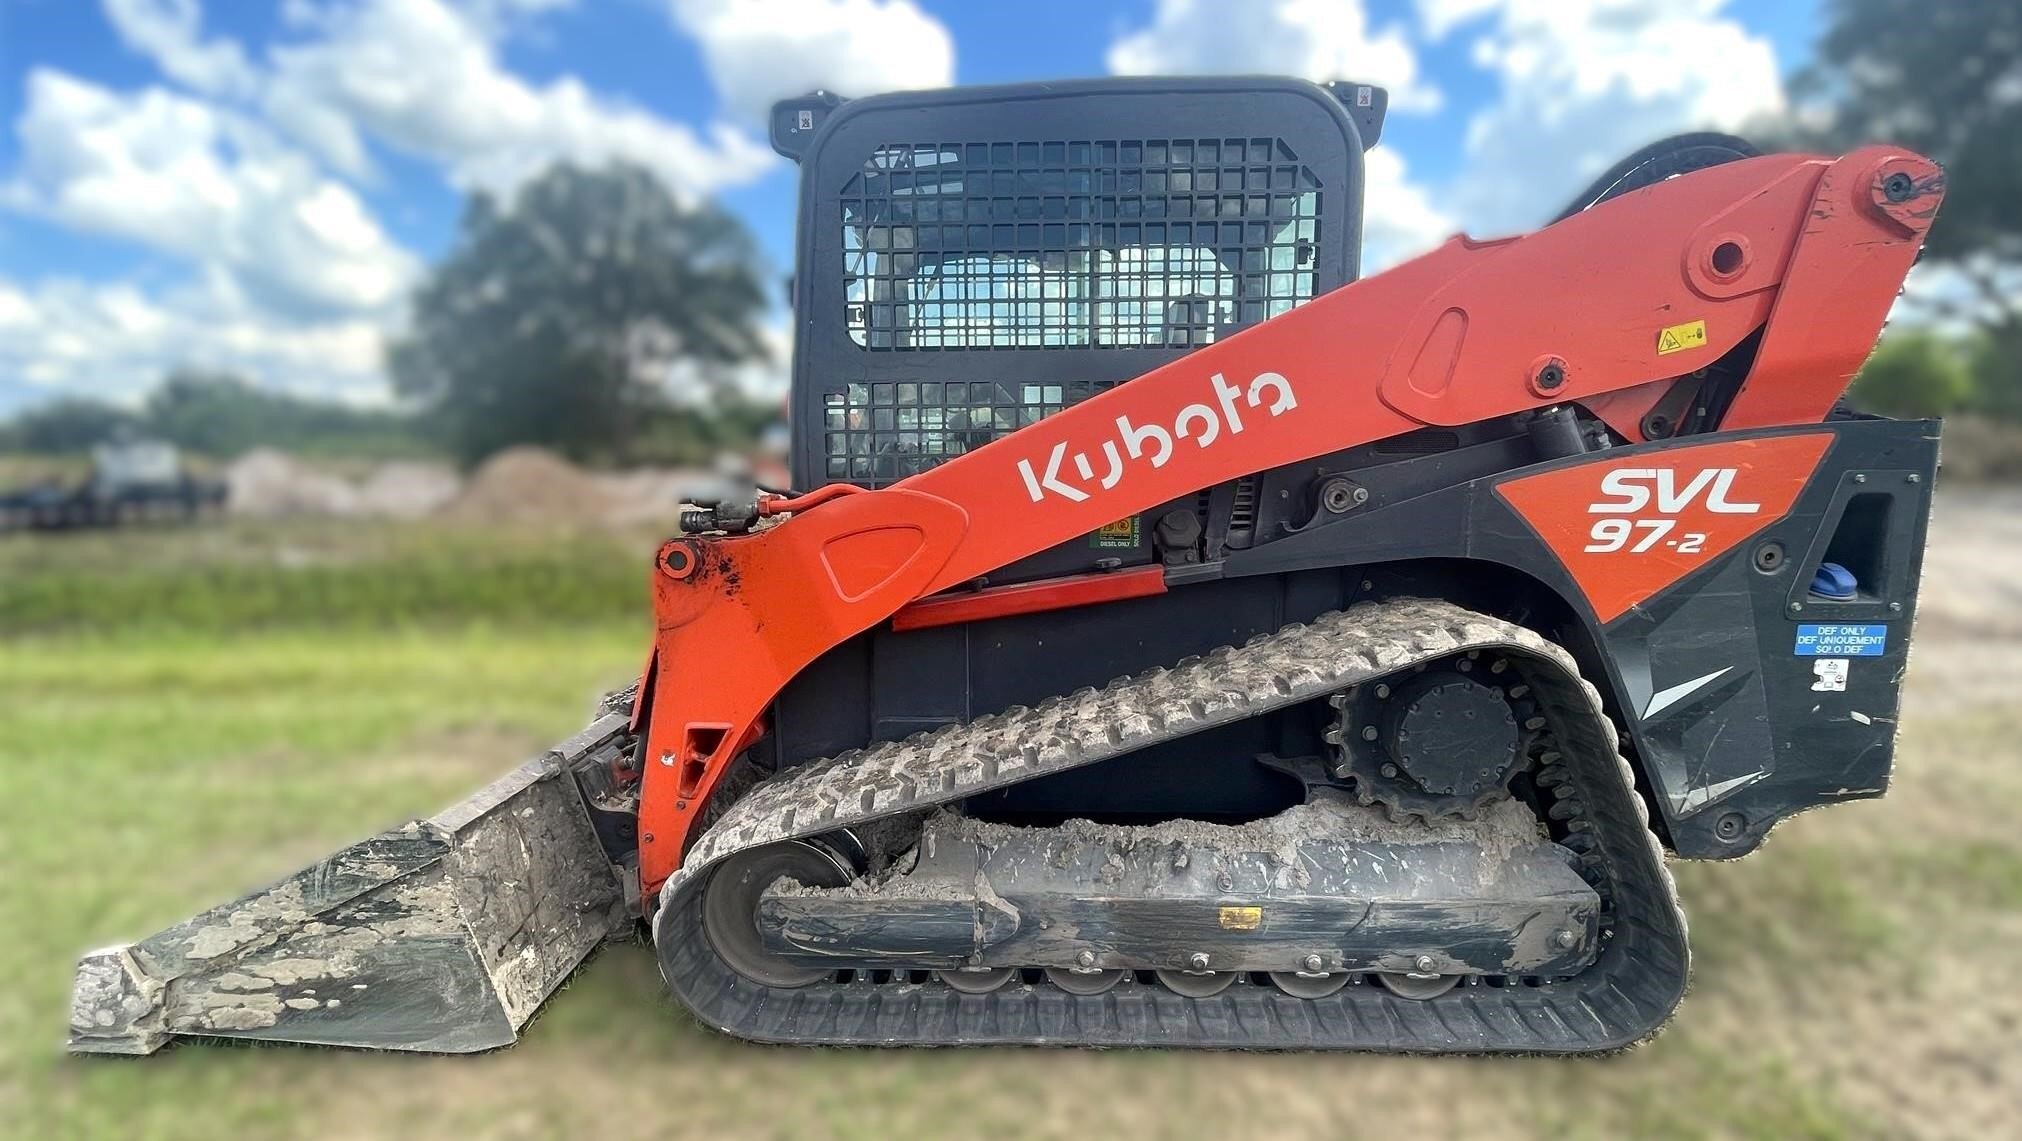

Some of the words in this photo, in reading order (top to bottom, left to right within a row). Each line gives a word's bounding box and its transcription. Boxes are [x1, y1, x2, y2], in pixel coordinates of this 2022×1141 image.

[1017, 372, 1298, 503] Kubota
[1588, 468, 1760, 513] SVL
[1584, 519, 1706, 553] 97-2
[1798, 636, 1817, 644] DEF
[1820, 636, 1884, 644] UNIQUEMENT
[1818, 627, 1837, 635] DEF
[1841, 627, 1866, 635] ONLY
[1844, 645, 1864, 653] DEF
